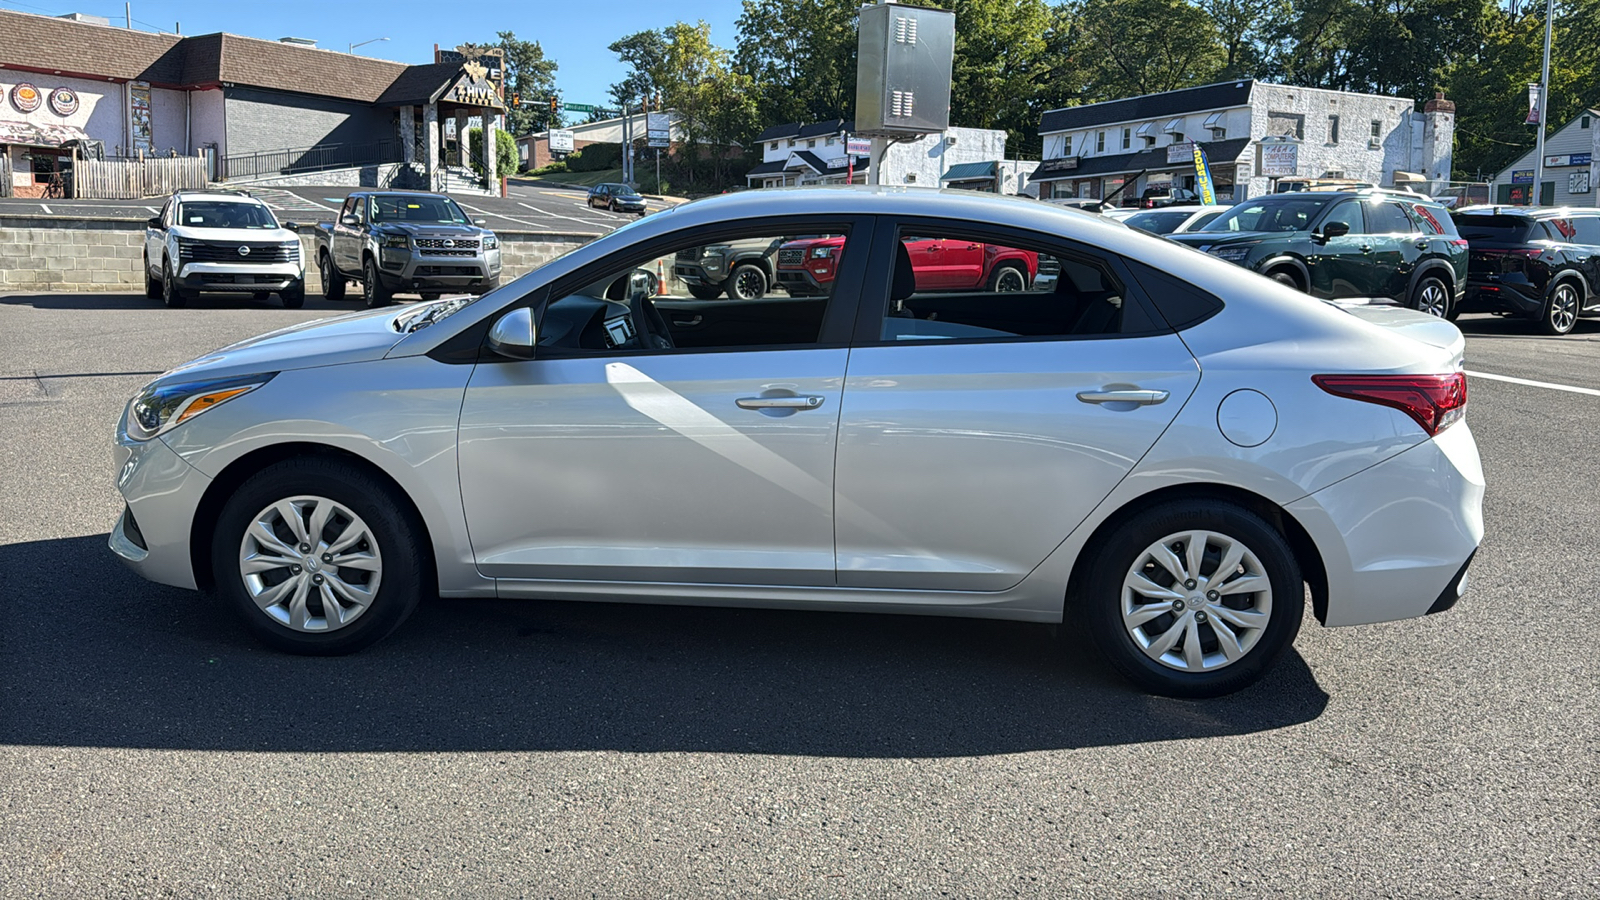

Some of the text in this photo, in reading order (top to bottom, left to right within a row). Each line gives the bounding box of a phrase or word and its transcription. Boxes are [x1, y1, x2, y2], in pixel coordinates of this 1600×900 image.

[467, 86, 494, 101] HIVE
[1263, 152, 1295, 160] COMPUTERS
[1262, 166, 1296, 174] 942-9700
